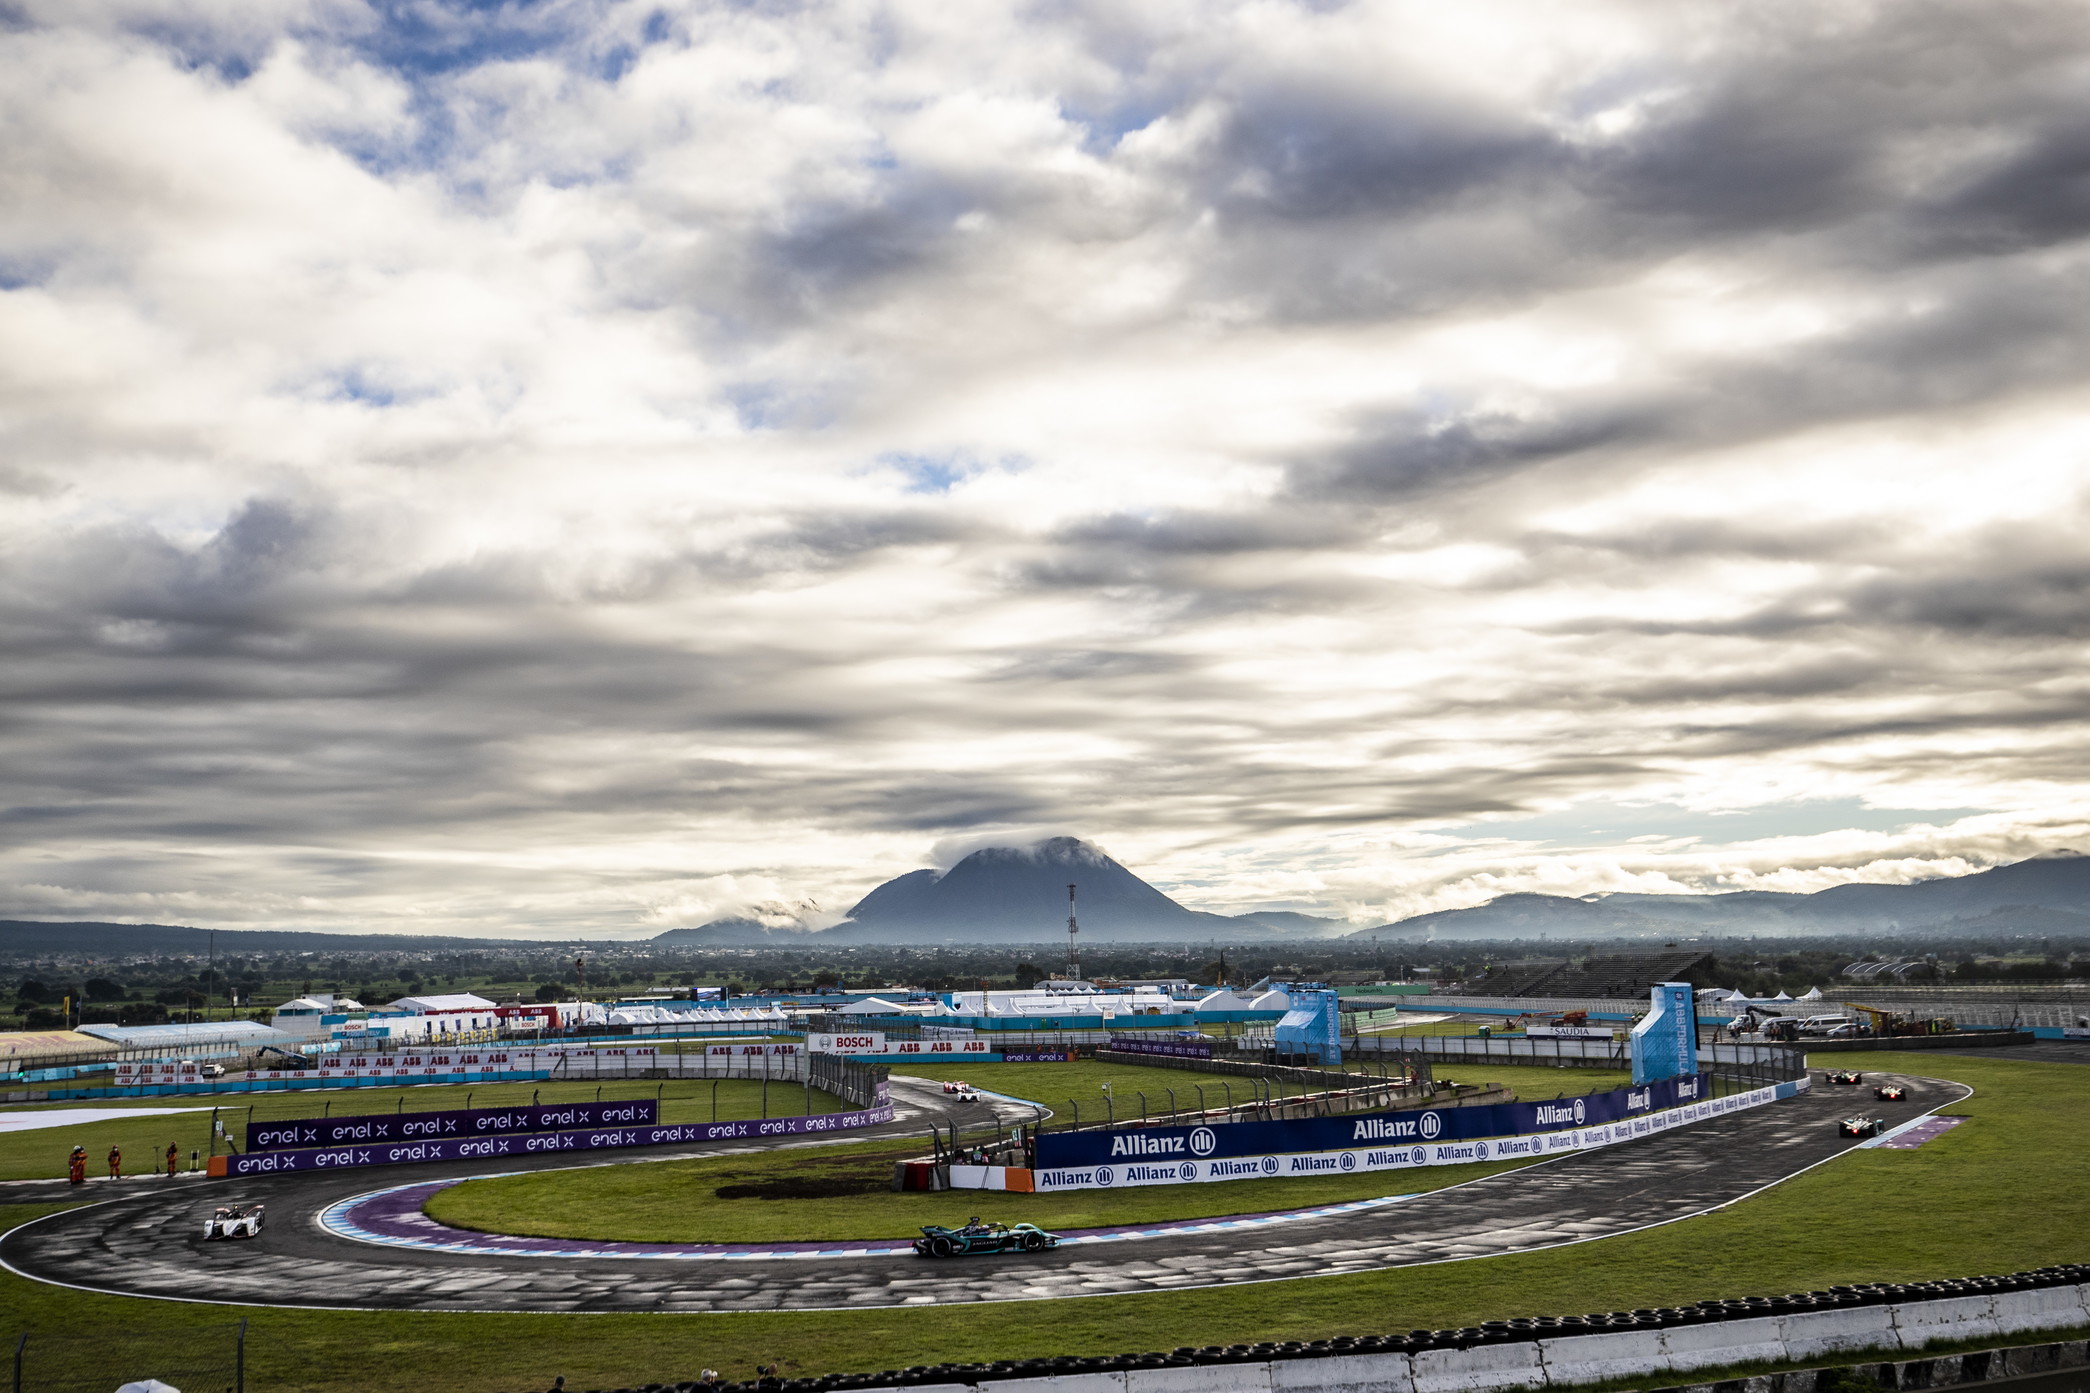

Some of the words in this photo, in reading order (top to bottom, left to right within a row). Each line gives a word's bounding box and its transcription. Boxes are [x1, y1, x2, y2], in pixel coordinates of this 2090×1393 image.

[836, 1037, 873, 1047] BOSCH
[1675, 1002, 1689, 1076] ABBFORMULA
[712, 1046, 732, 1055] ABB
[743, 1046, 763, 1055] ABB
[773, 1045, 794, 1055] ABB
[899, 1043, 920, 1053] ABB
[931, 1042, 952, 1052] ABB
[963, 1042, 985, 1051] ABB
[324, 1059, 341, 1067] ABB
[349, 1058, 367, 1067] ABB
[376, 1057, 393, 1067] ABB
[402, 1057, 421, 1066] ABB
[430, 1056, 450, 1065] ABB
[459, 1055, 479, 1064] ABB
[488, 1054, 508, 1063] ABB
[1006, 1053, 1024, 1062] enel
[1039, 1053, 1057, 1061] enel
[118, 1065, 132, 1074] ABB
[160, 1065, 175, 1074] ABB
[181, 1065, 196, 1074] ABB
[269, 1070, 281, 1078] ABB
[318, 1069, 330, 1077] ABB
[369, 1068, 381, 1076] ABB
[258, 1126, 298, 1145] enel
[332, 1122, 371, 1140] enel
[403, 1117, 440, 1135] enel
[476, 1113, 512, 1130] enel
[540, 1109, 575, 1126] enel
[602, 1106, 634, 1122] enel
[1111, 1134, 1185, 1156] Allianz
[1353, 1118, 1417, 1140] Allianz
[1536, 1105, 1573, 1125] Allianz
[1627, 1093, 1644, 1111] Allianz
[237, 1154, 278, 1173] enel
[315, 1149, 353, 1166] enel
[389, 1144, 425, 1161] enel
[459, 1138, 494, 1155] enel
[526, 1134, 559, 1150] enel
[590, 1130, 623, 1146] enel
[651, 1126, 681, 1142] enel
[708, 1123, 735, 1138] enel
[760, 1120, 785, 1134] enel
[805, 1116, 826, 1130] enel
[842, 1113, 859, 1127] enel
[1041, 1172, 1092, 1187] Allianz
[1126, 1166, 1176, 1181] Allianz
[1210, 1161, 1259, 1176] Allianz
[1291, 1157, 1337, 1171] Allianz
[1367, 1151, 1409, 1166] Allianz
[1436, 1147, 1474, 1160] Allianz
[1497, 1141, 1530, 1155] Allianz
[1548, 1134, 1571, 1149] Allianz
[1584, 1130, 1604, 1144] Allianz
[1615, 1126, 1628, 1139] Allianz
[1634, 1122, 1646, 1134] Allianz
